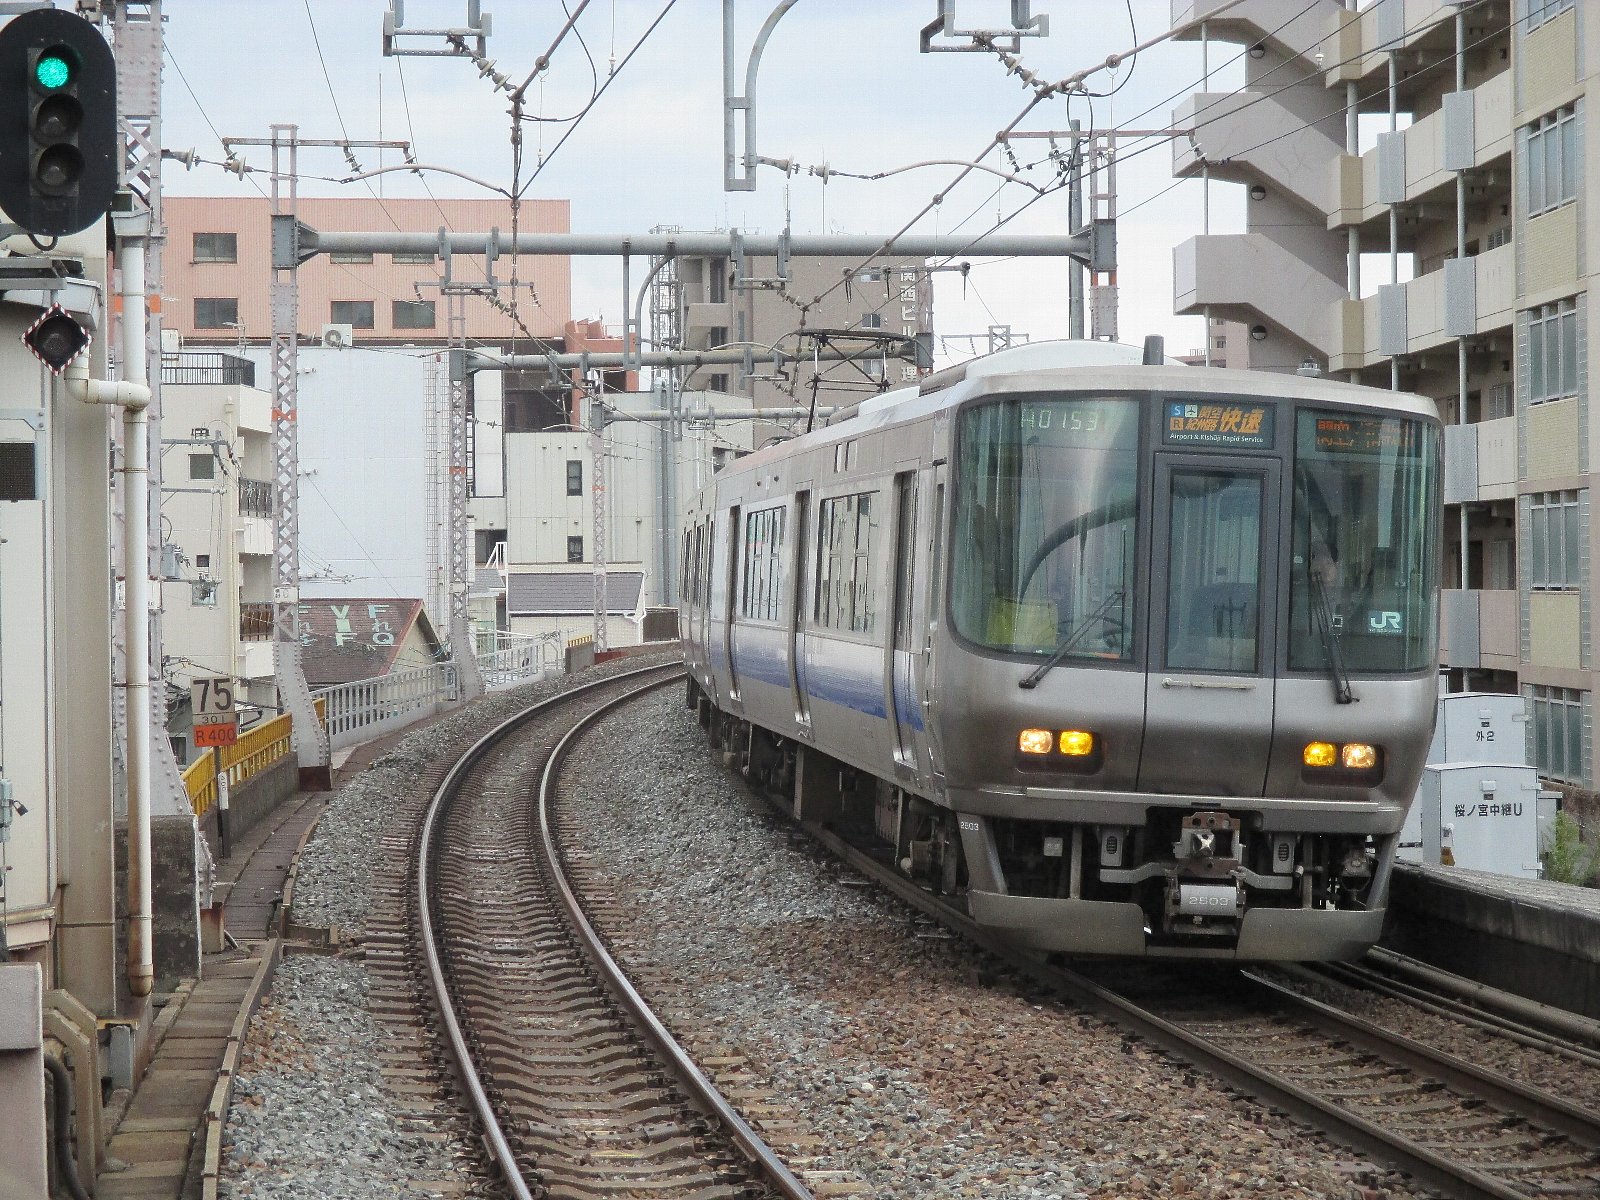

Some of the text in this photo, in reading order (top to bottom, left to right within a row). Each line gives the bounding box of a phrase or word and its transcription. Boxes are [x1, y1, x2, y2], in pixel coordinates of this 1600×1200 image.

[900, 265, 917, 382] 関西ビル理
[1219, 406, 1264, 433] 快速
[1169, 432, 1193, 441] Airport
[1240, 435, 1264, 443] Service
[1370, 611, 1401, 629] JR
[193, 677, 232, 713] 75
[1454, 802, 1523, 818] 桜ノ宮中継U
